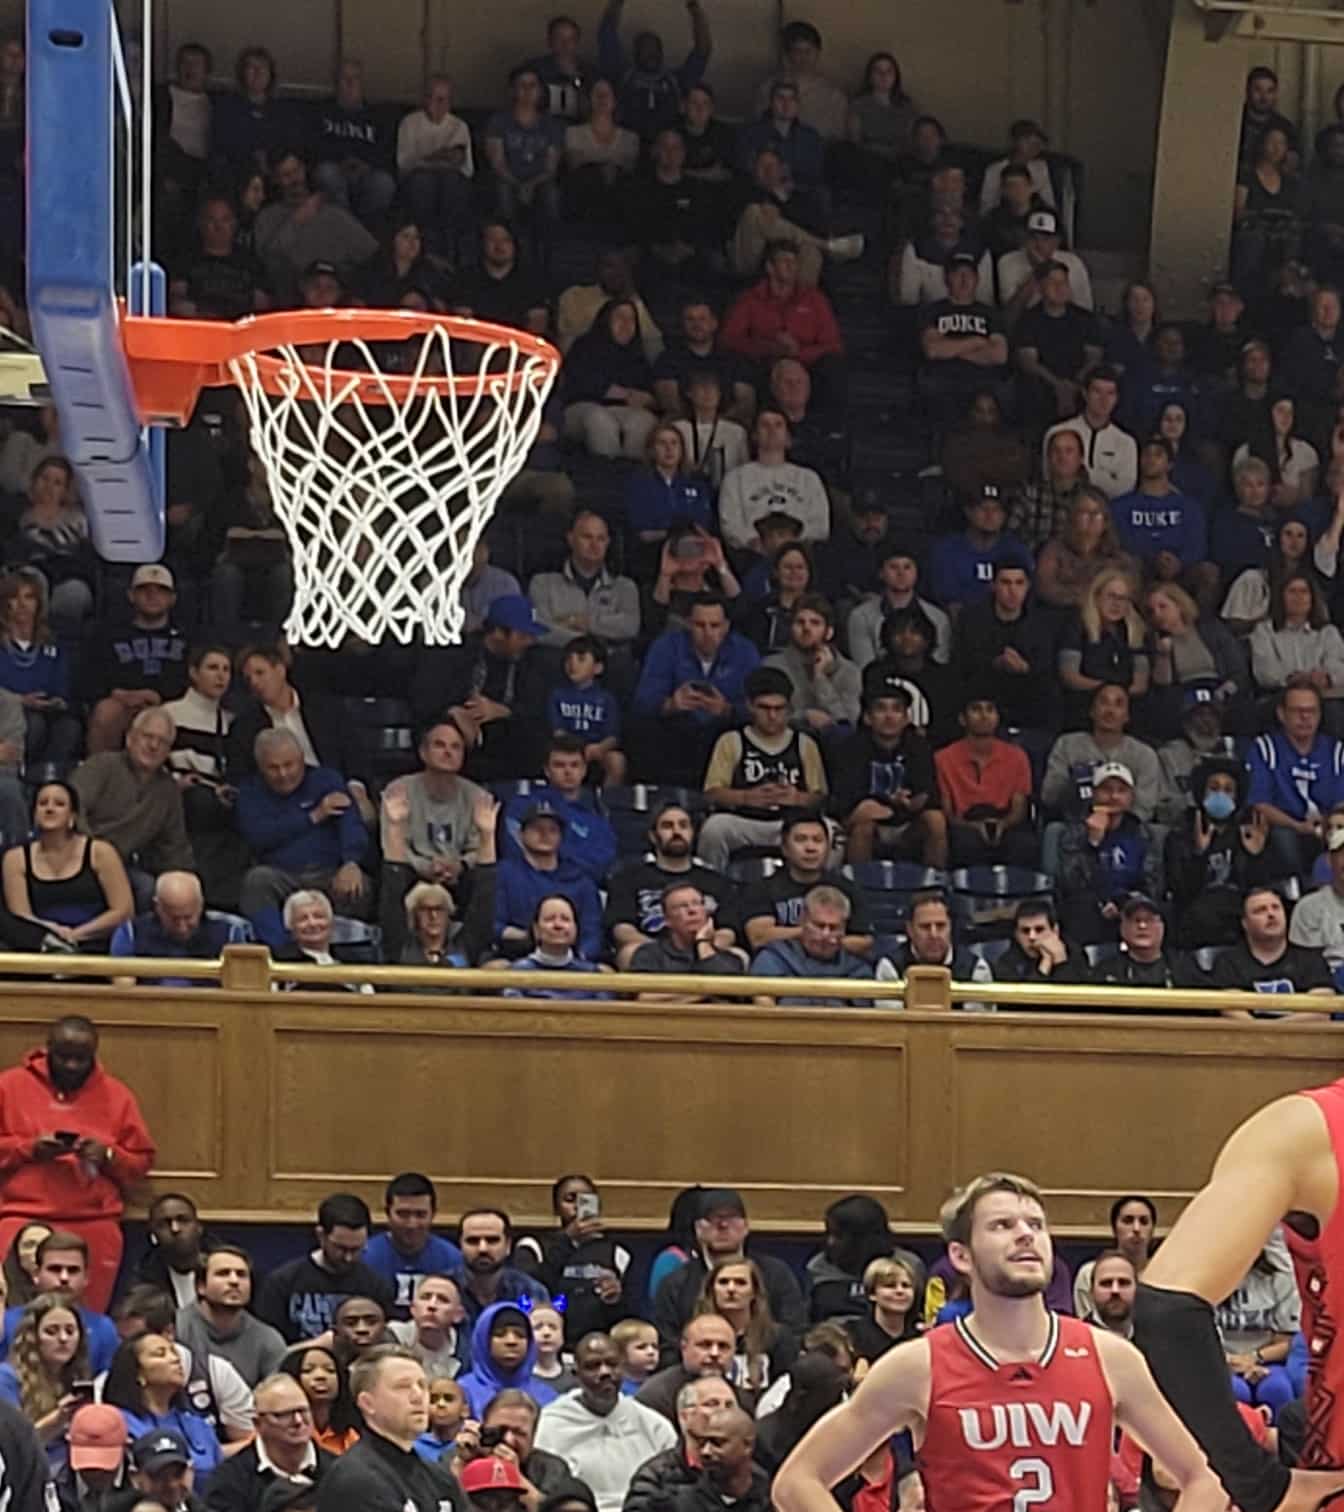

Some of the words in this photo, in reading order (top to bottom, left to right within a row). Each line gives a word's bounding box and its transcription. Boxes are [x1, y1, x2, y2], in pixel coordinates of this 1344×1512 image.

[938, 315, 987, 334] DUKE
[1132, 510, 1182, 527] DUKE
[560, 702, 604, 721] DUKE
[959, 1400, 1092, 1451] UIW
